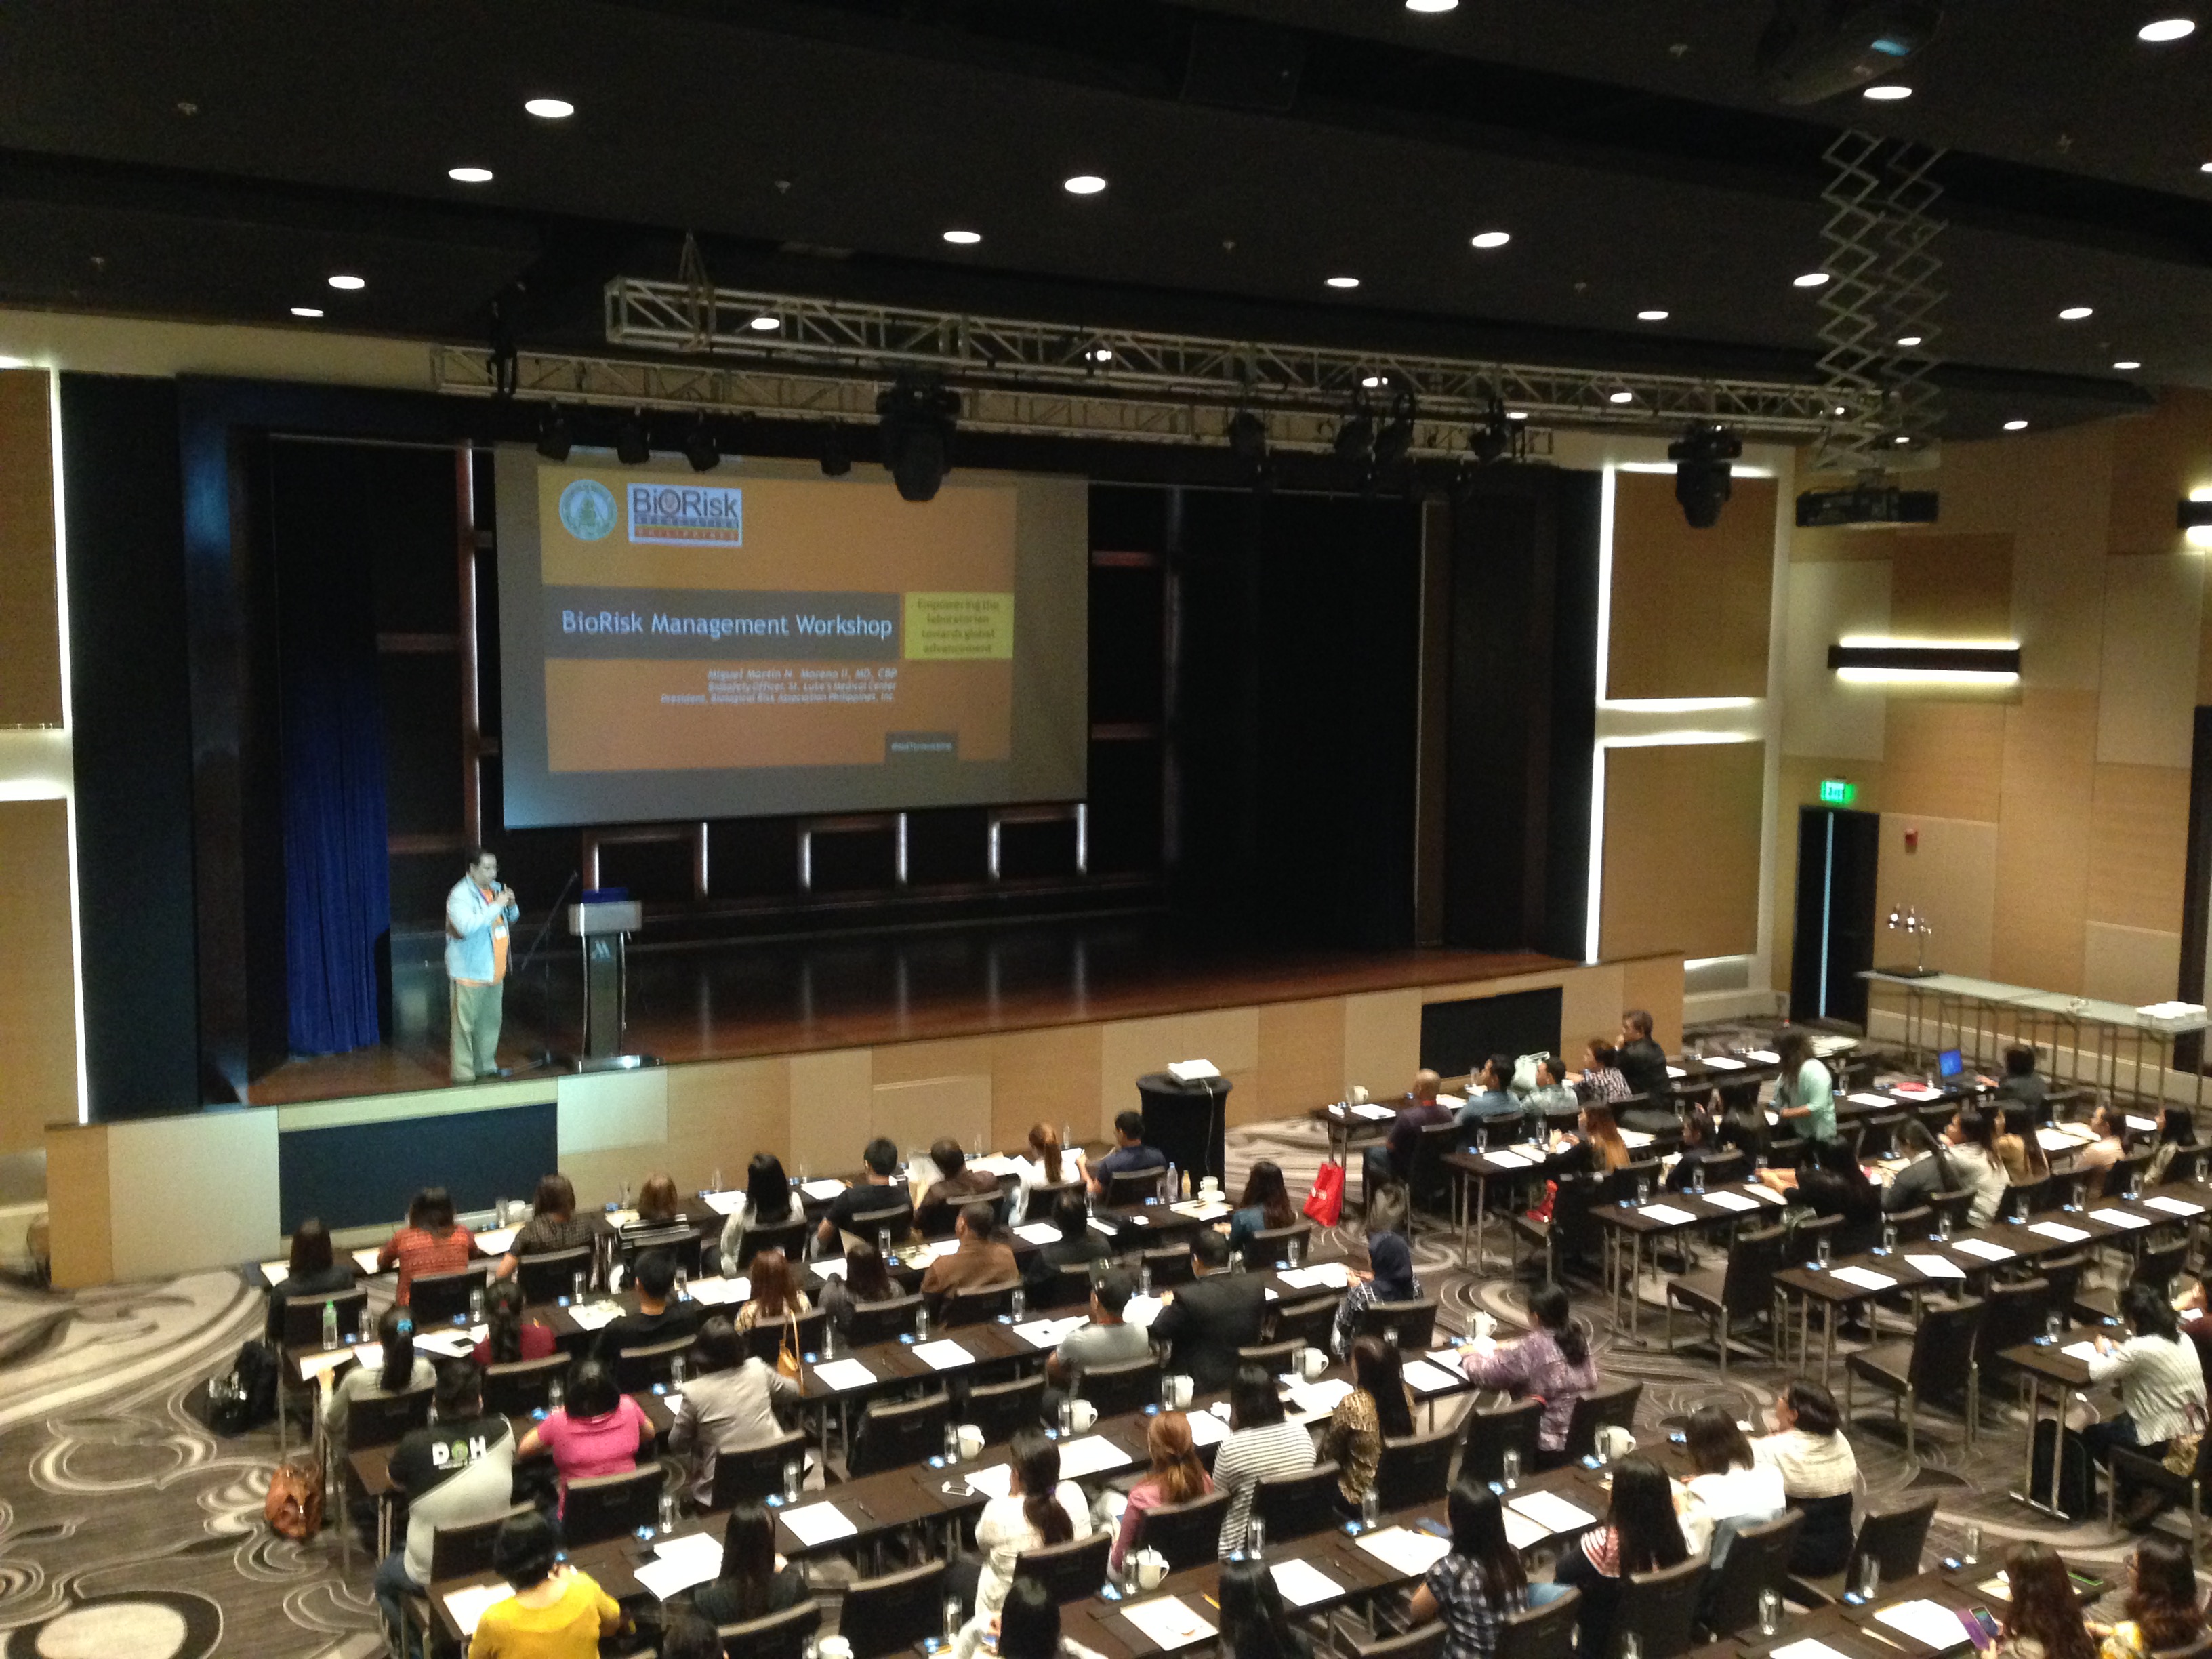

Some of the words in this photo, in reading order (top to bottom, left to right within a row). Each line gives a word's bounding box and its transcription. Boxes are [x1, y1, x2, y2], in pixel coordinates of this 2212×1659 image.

[562, 609, 643, 634] BioRisk
[651, 613, 789, 641] Management
[796, 615, 893, 640] Workshop
